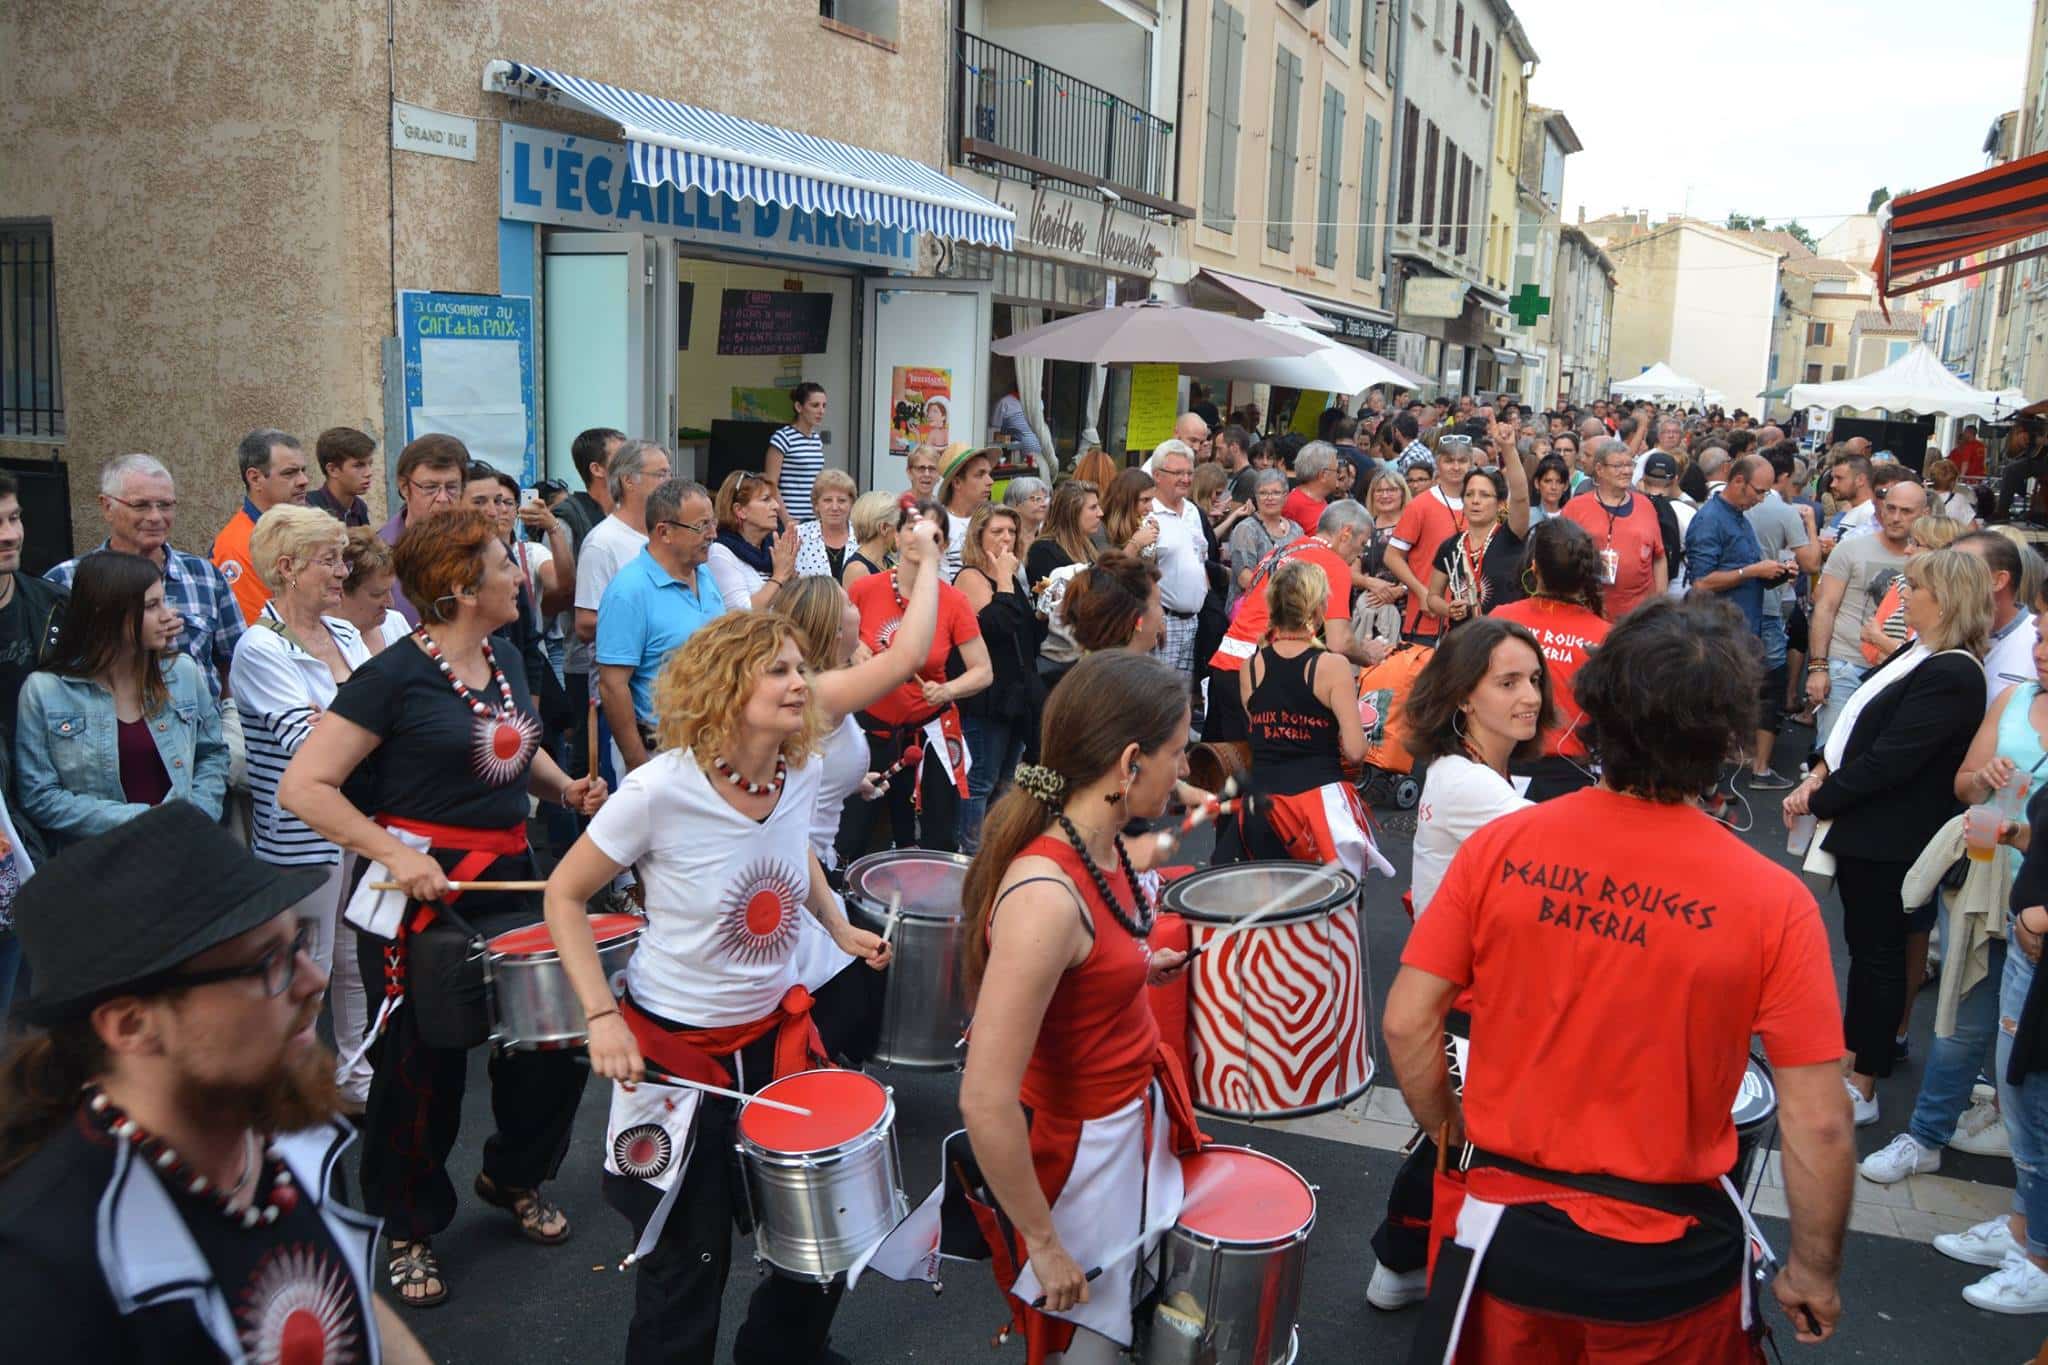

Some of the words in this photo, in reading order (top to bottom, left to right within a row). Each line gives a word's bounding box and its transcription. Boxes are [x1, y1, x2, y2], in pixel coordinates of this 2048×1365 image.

[404, 125, 446, 144] GRAND'
[448, 131, 467, 149] RUE
[514, 138, 741, 233] L'ÉCAILLE
[754, 199, 916, 258] DARGENT
[496, 305, 513, 320] au
[418, 314, 453, 336] CAFÉ
[467, 319, 481, 336] la
[482, 319, 517, 337] PAIX
[1542, 645, 1573, 663] ERIA
[1264, 725, 1312, 740] BATERIA
[1501, 857, 1589, 896] PEAUX
[1598, 873, 1717, 930] ROUGES
[1537, 894, 1647, 948] BATERIA
